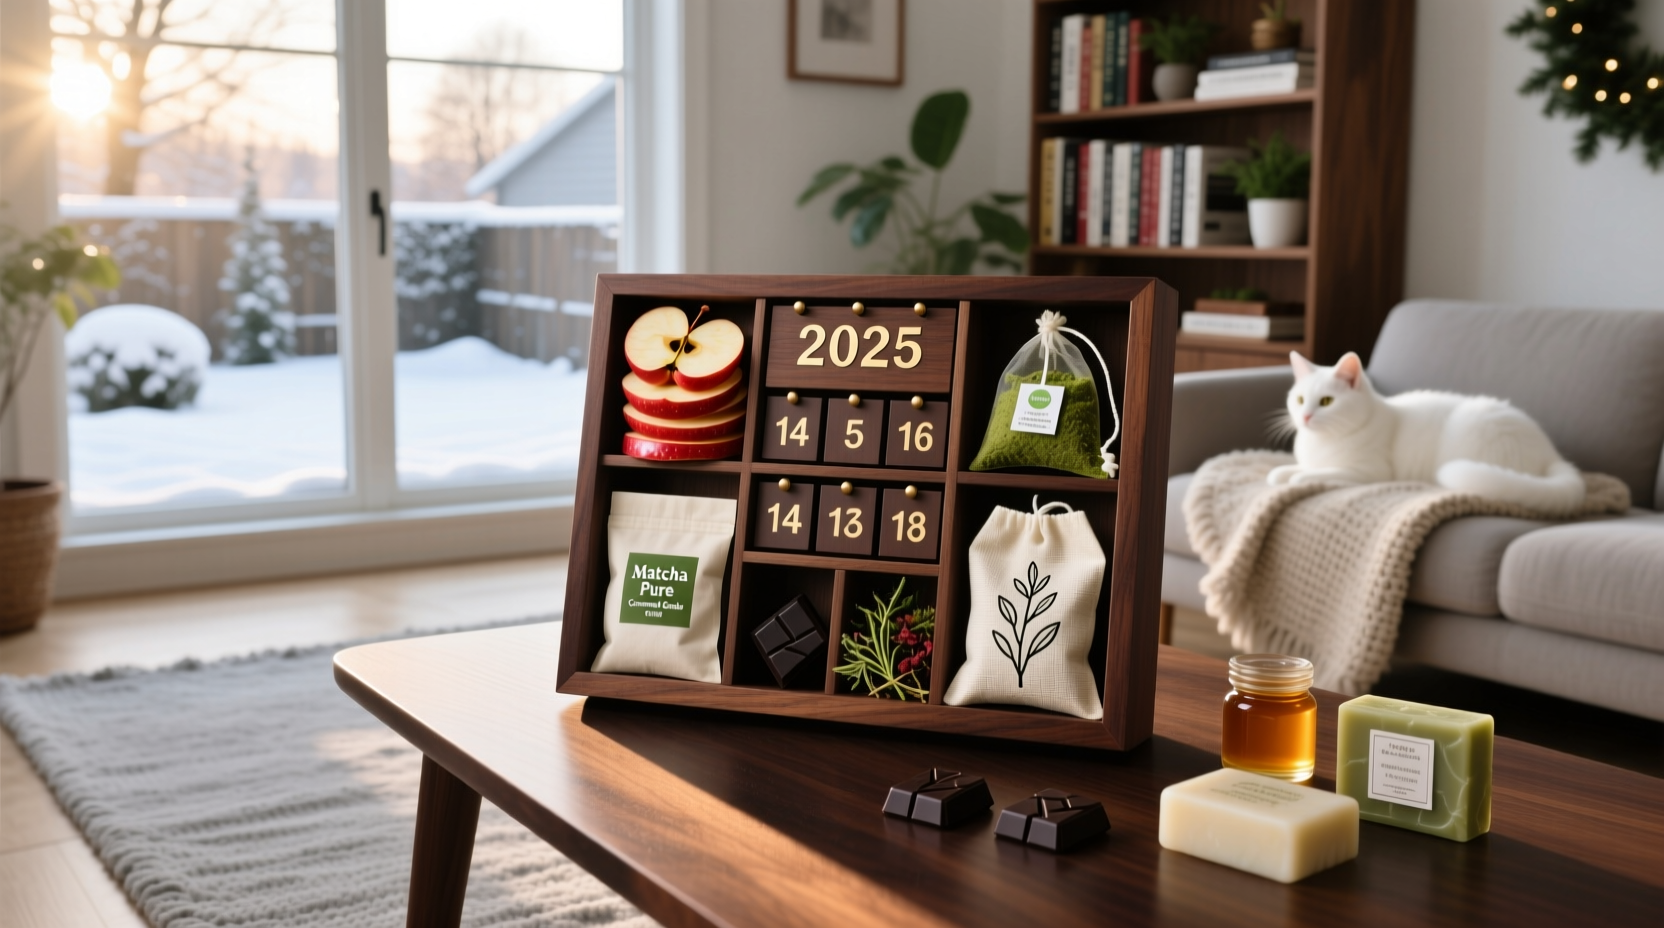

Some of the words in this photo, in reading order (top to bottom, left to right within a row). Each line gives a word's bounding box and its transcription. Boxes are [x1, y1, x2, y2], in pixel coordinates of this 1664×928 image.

[797, 324, 922, 369] 2025
[776, 416, 809, 447] 14
[844, 419, 864, 449] 5
[898, 421, 934, 452] 16
[767, 502, 802, 534] 14
[891, 510, 926, 543] 18
[632, 564, 688, 582] Matcha
[640, 581, 674, 597] Pure
